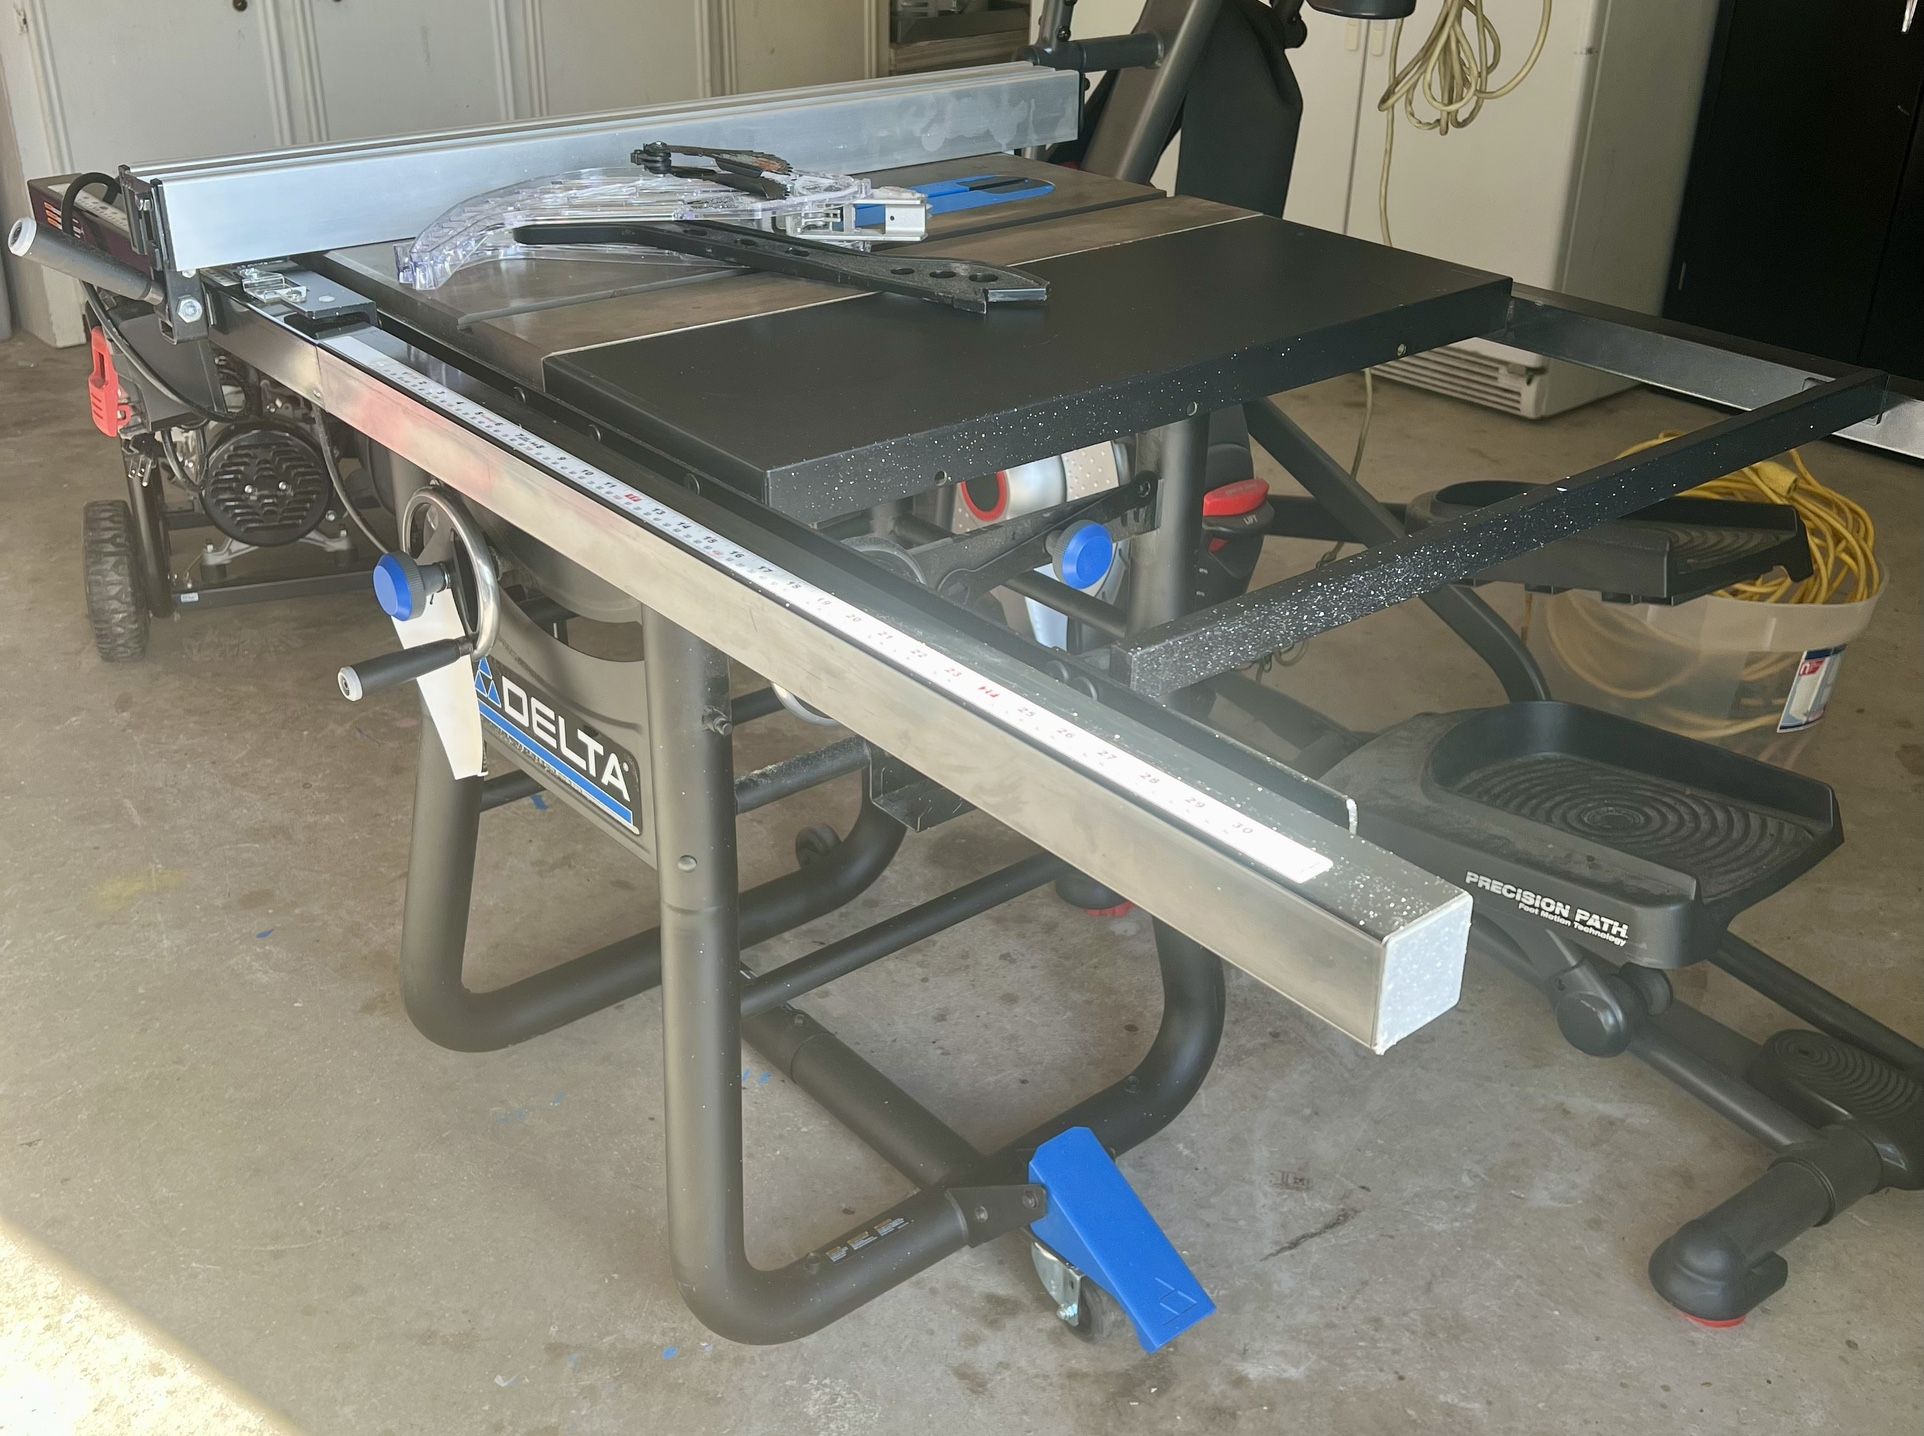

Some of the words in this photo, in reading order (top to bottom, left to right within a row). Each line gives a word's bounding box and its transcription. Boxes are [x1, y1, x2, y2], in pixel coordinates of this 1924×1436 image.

[652, 507, 667, 516] 13
[676, 521, 693, 529] 14
[703, 535, 718, 544] 15
[729, 550, 745, 559] 16
[757, 565, 773, 573] 17
[786, 581, 802, 589] 18
[816, 597, 833, 605] 19
[1138, 771, 1161, 785] 28
[1184, 796, 1207, 809] 29
[1231, 821, 1255, 835] 30
[501, 674, 632, 803] DELTA
[1465, 871, 1571, 918] PRECISION
[1518, 902, 1540, 915] Foot
[1540, 910, 1572, 927] Motion
[1573, 921, 1627, 947] Technology
